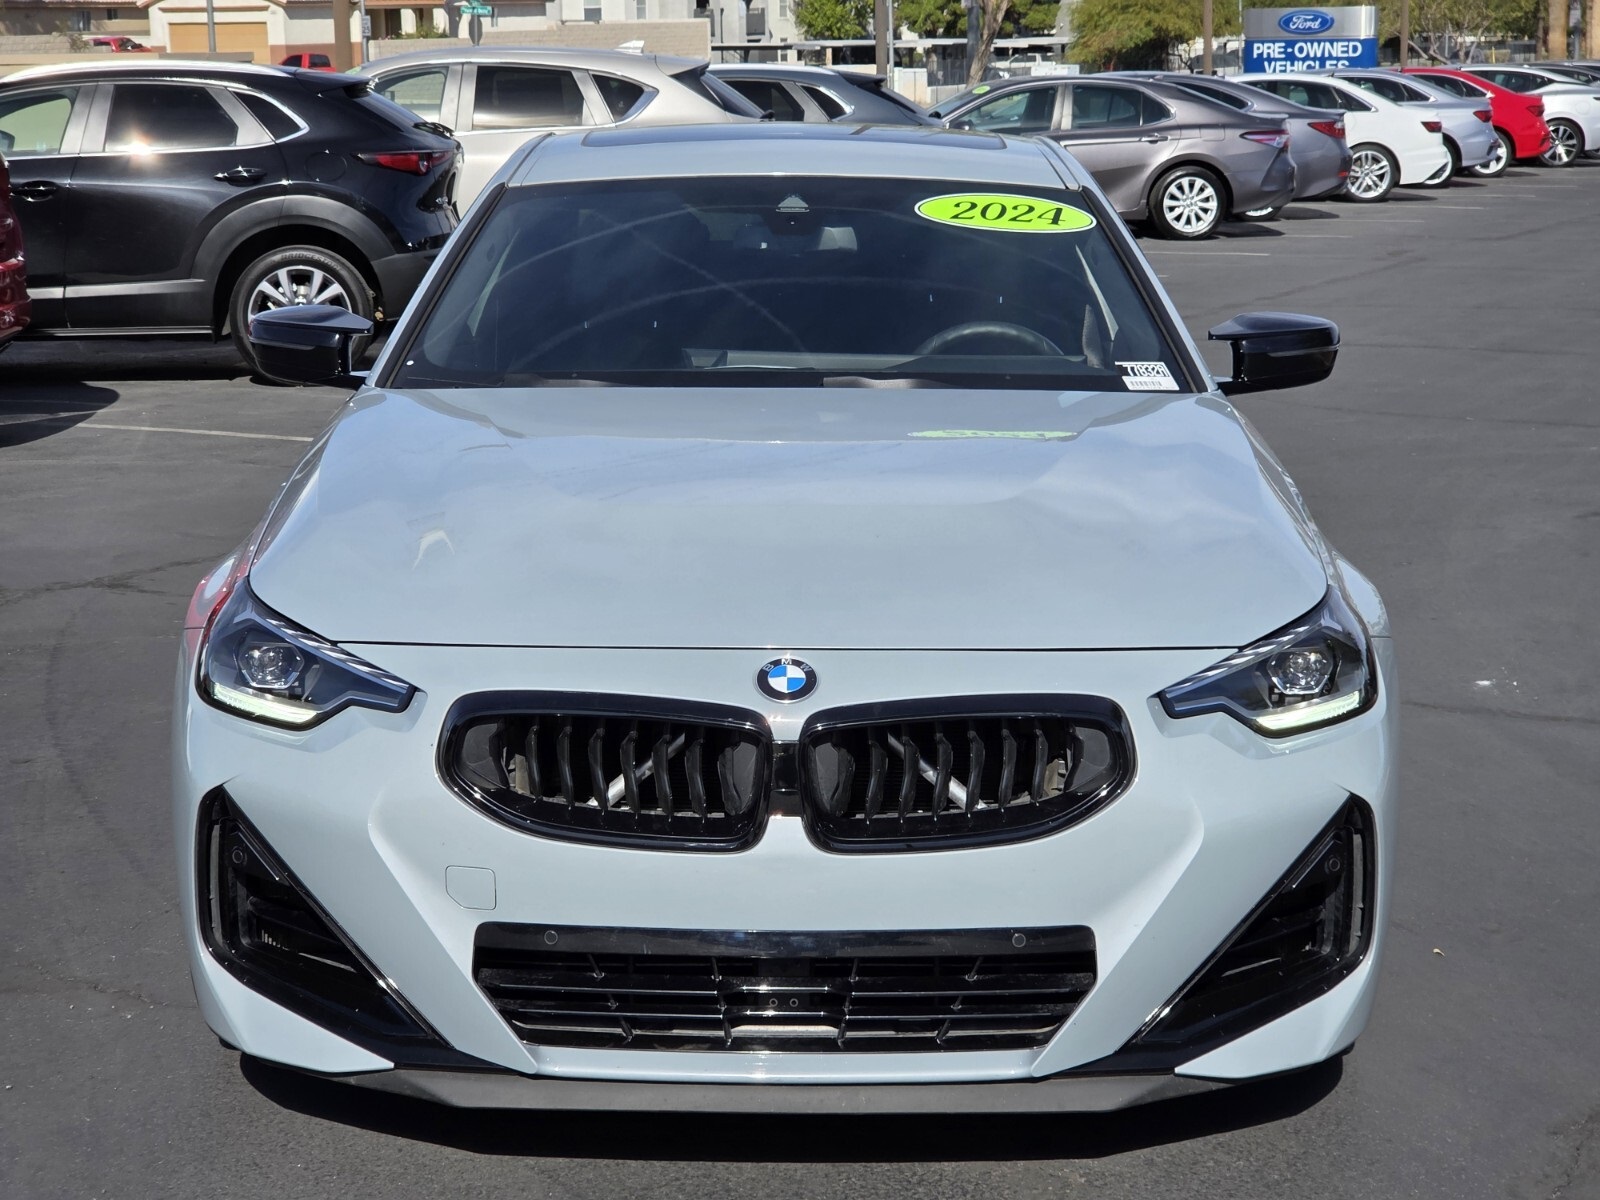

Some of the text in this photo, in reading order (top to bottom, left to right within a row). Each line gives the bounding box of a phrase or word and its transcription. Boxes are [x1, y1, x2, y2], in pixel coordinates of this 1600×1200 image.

[1289, 15, 1322, 29] Ford
[1253, 41, 1362, 58] PRE-OWNED
[950, 201, 1067, 226] 2024
[762, 658, 813, 672] BMW
